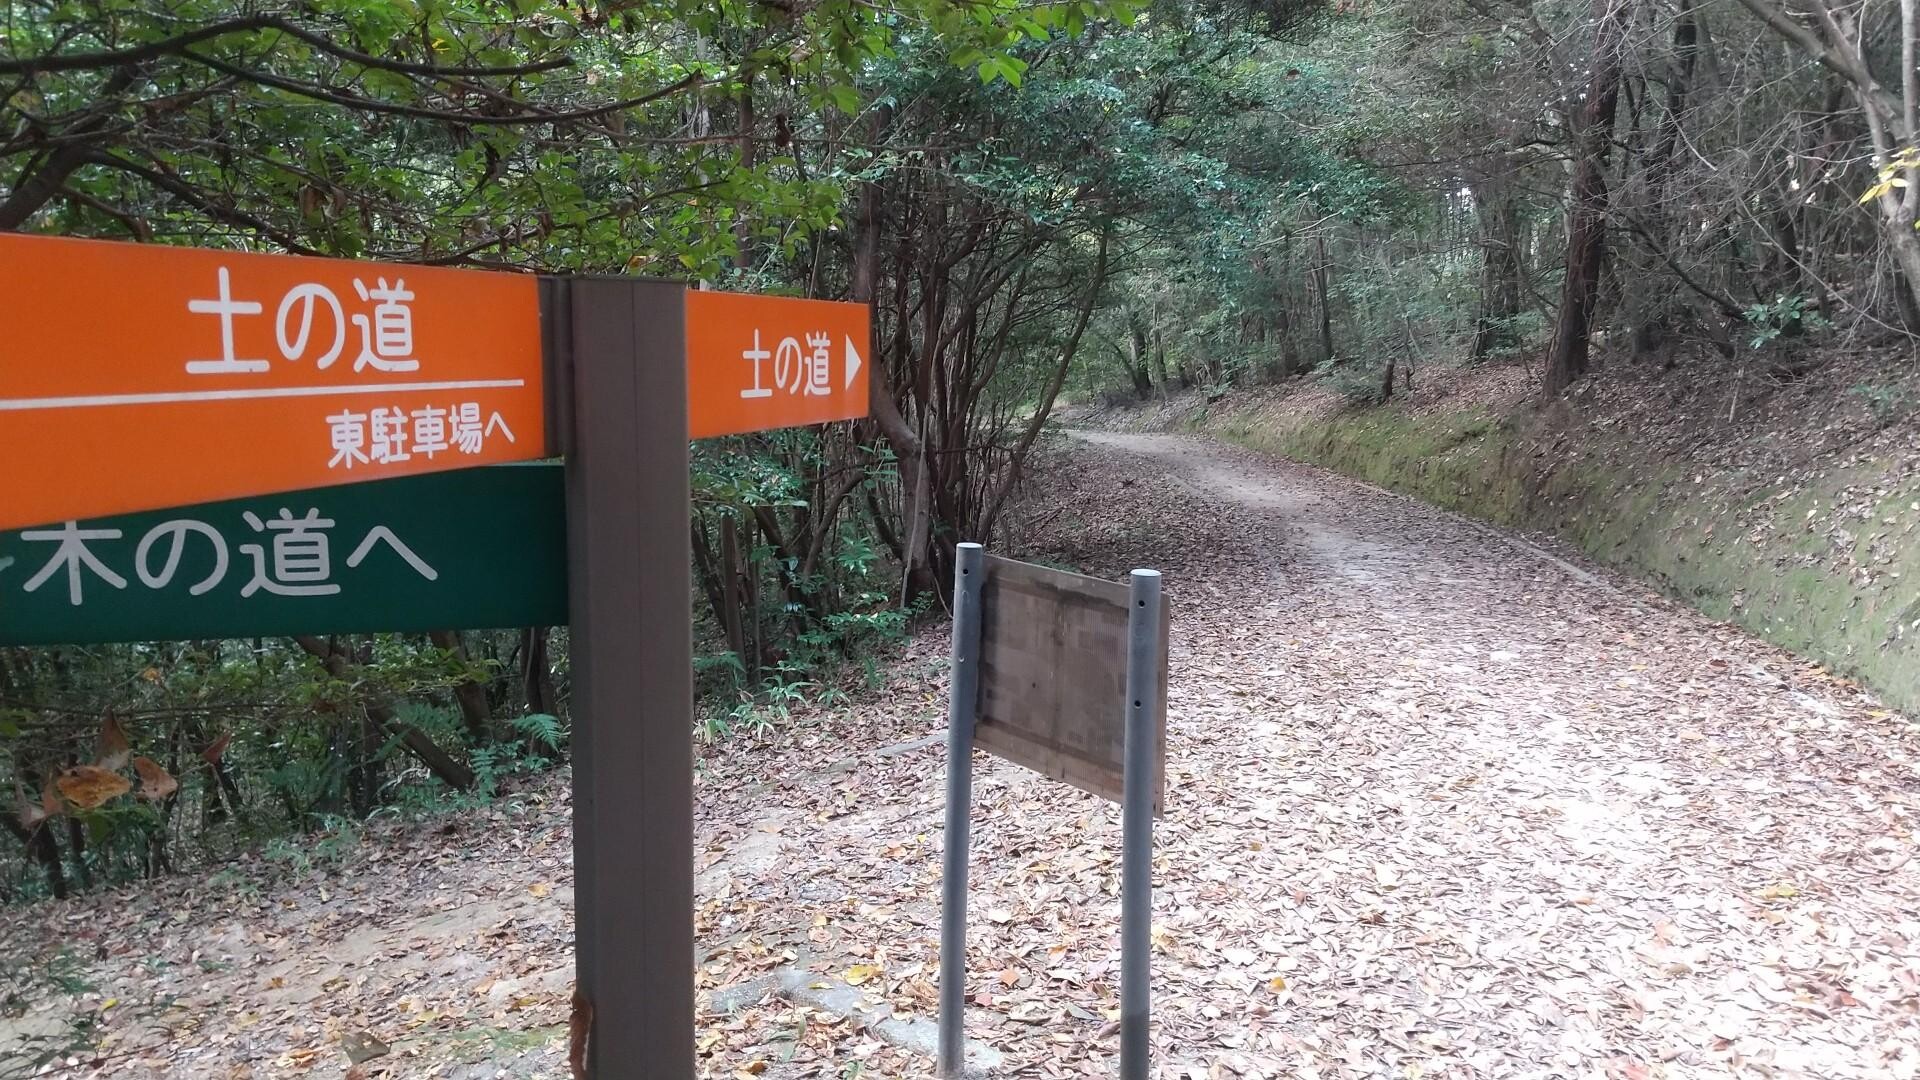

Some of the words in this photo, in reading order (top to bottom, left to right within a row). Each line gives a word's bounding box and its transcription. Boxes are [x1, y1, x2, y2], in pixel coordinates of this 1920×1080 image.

[185, 266, 420, 374] 土の道
[740, 328, 832, 399] 土の道
[326, 402, 516, 469] 東駐車場へ
[20, 507, 439, 606] 木の道へ
